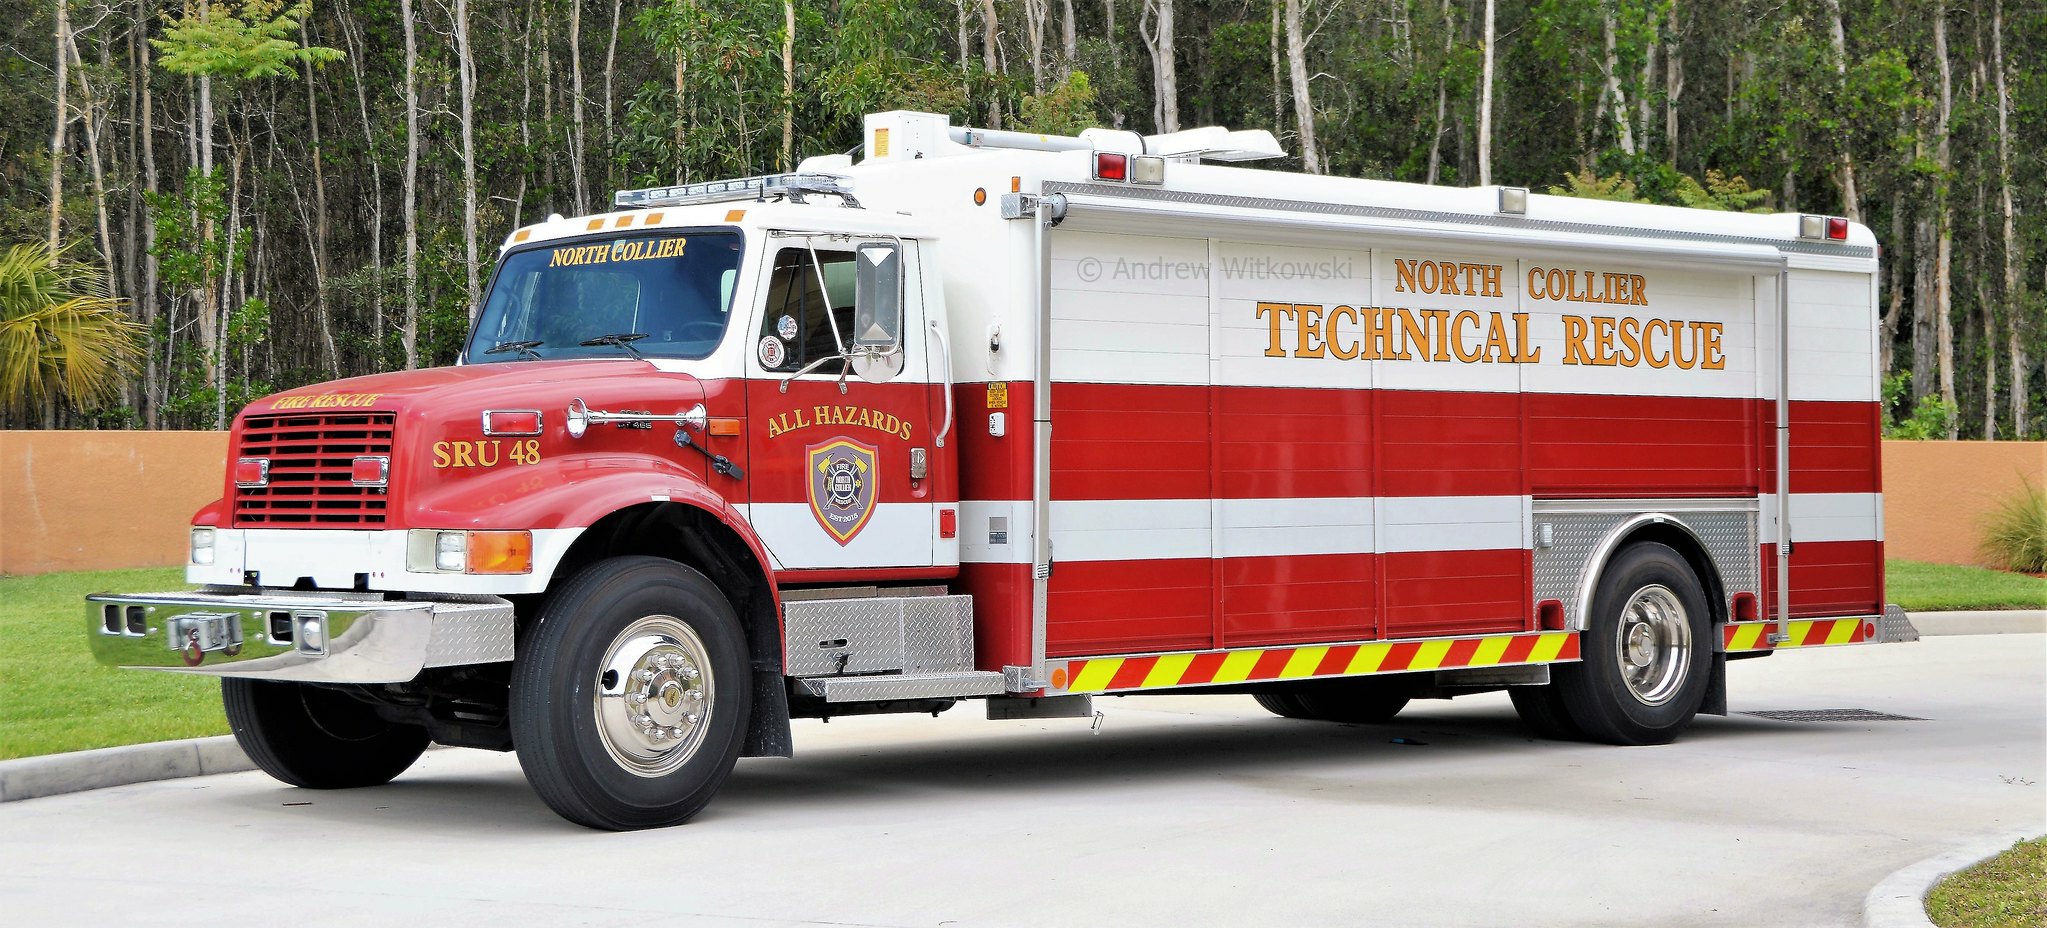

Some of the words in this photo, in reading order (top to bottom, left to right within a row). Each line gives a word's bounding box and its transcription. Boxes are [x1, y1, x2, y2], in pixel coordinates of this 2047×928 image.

[549, 244, 612, 268] NORTH
[611, 238, 687, 262] COLLIER
[1394, 258, 1504, 298] NORTH
[1527, 266, 1649, 306] COLLIER
[1255, 301, 1541, 364] TECHNICAL
[1561, 314, 1726, 371] RESCUE
[269, 395, 316, 410] FIRE
[308, 393, 384, 408] RESCUE
[768, 409, 810, 439] ALL
[813, 405, 913, 441] HAZARDS
[432, 440, 501, 468] SRU
[509, 439, 541, 465] 48
[834, 483, 851, 491] COLLIER
[829, 512, 842, 522] EST
